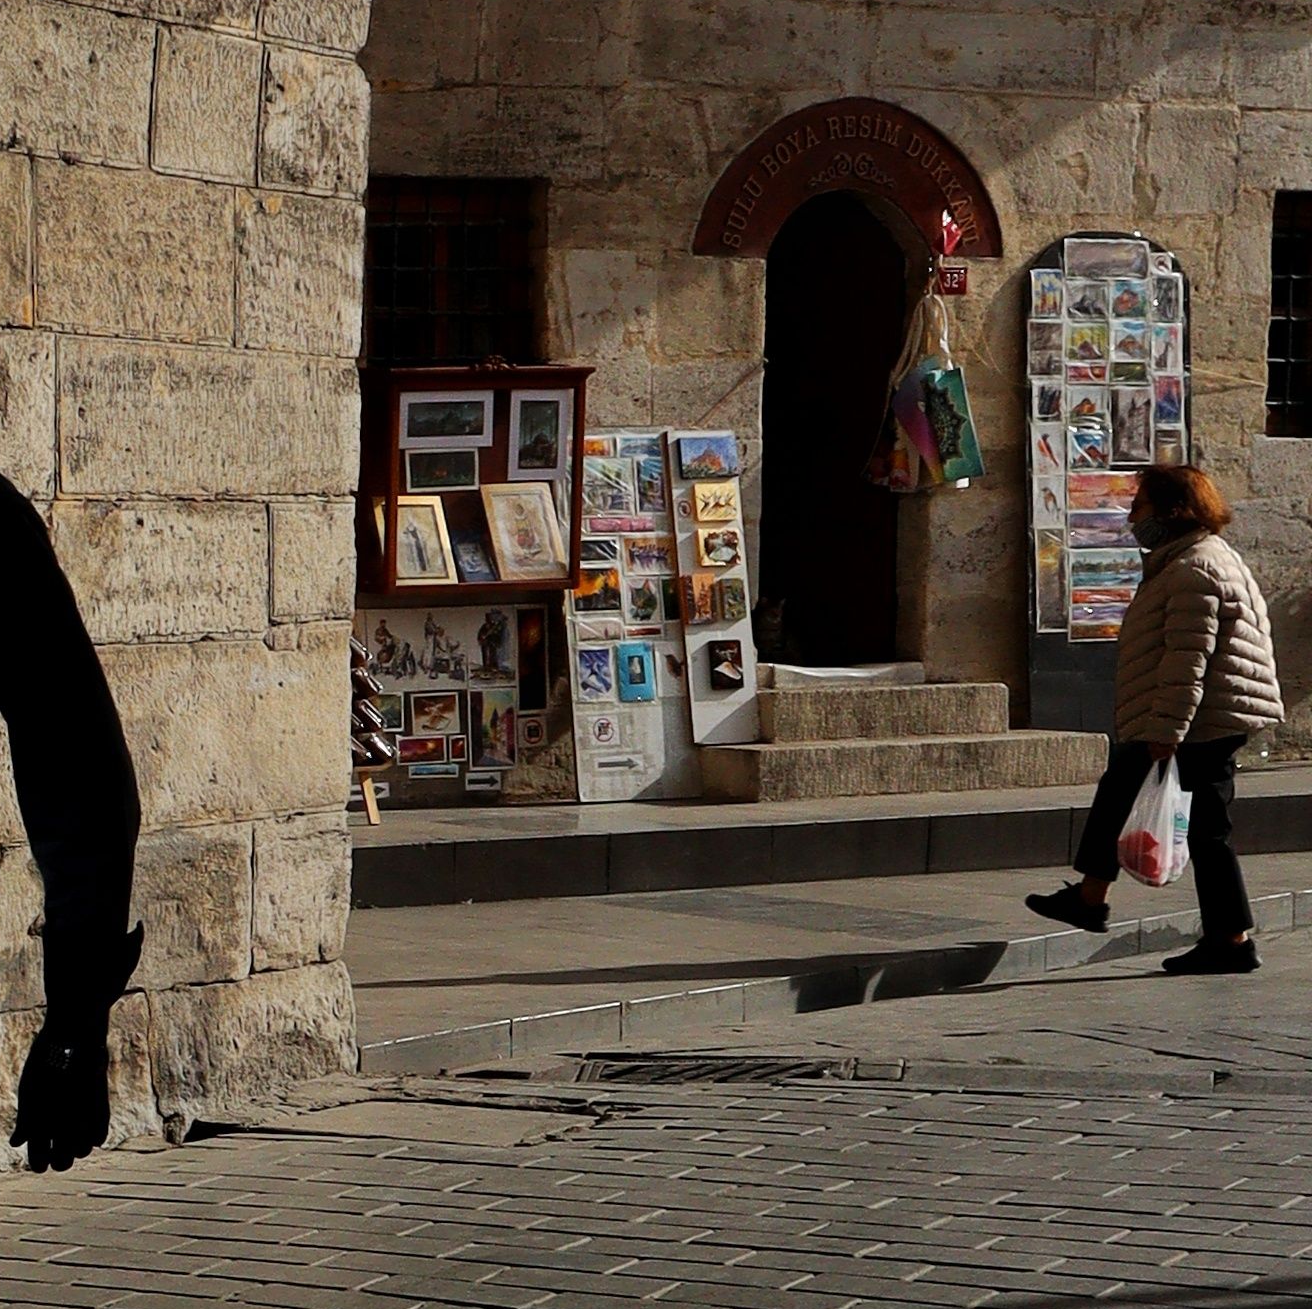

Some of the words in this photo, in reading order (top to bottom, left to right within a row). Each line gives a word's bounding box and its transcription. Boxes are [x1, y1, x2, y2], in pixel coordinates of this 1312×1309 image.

[722, 175, 763, 248] SULU
[761, 125, 821, 177] BOYA
[826, 114, 903, 146] RESİM
